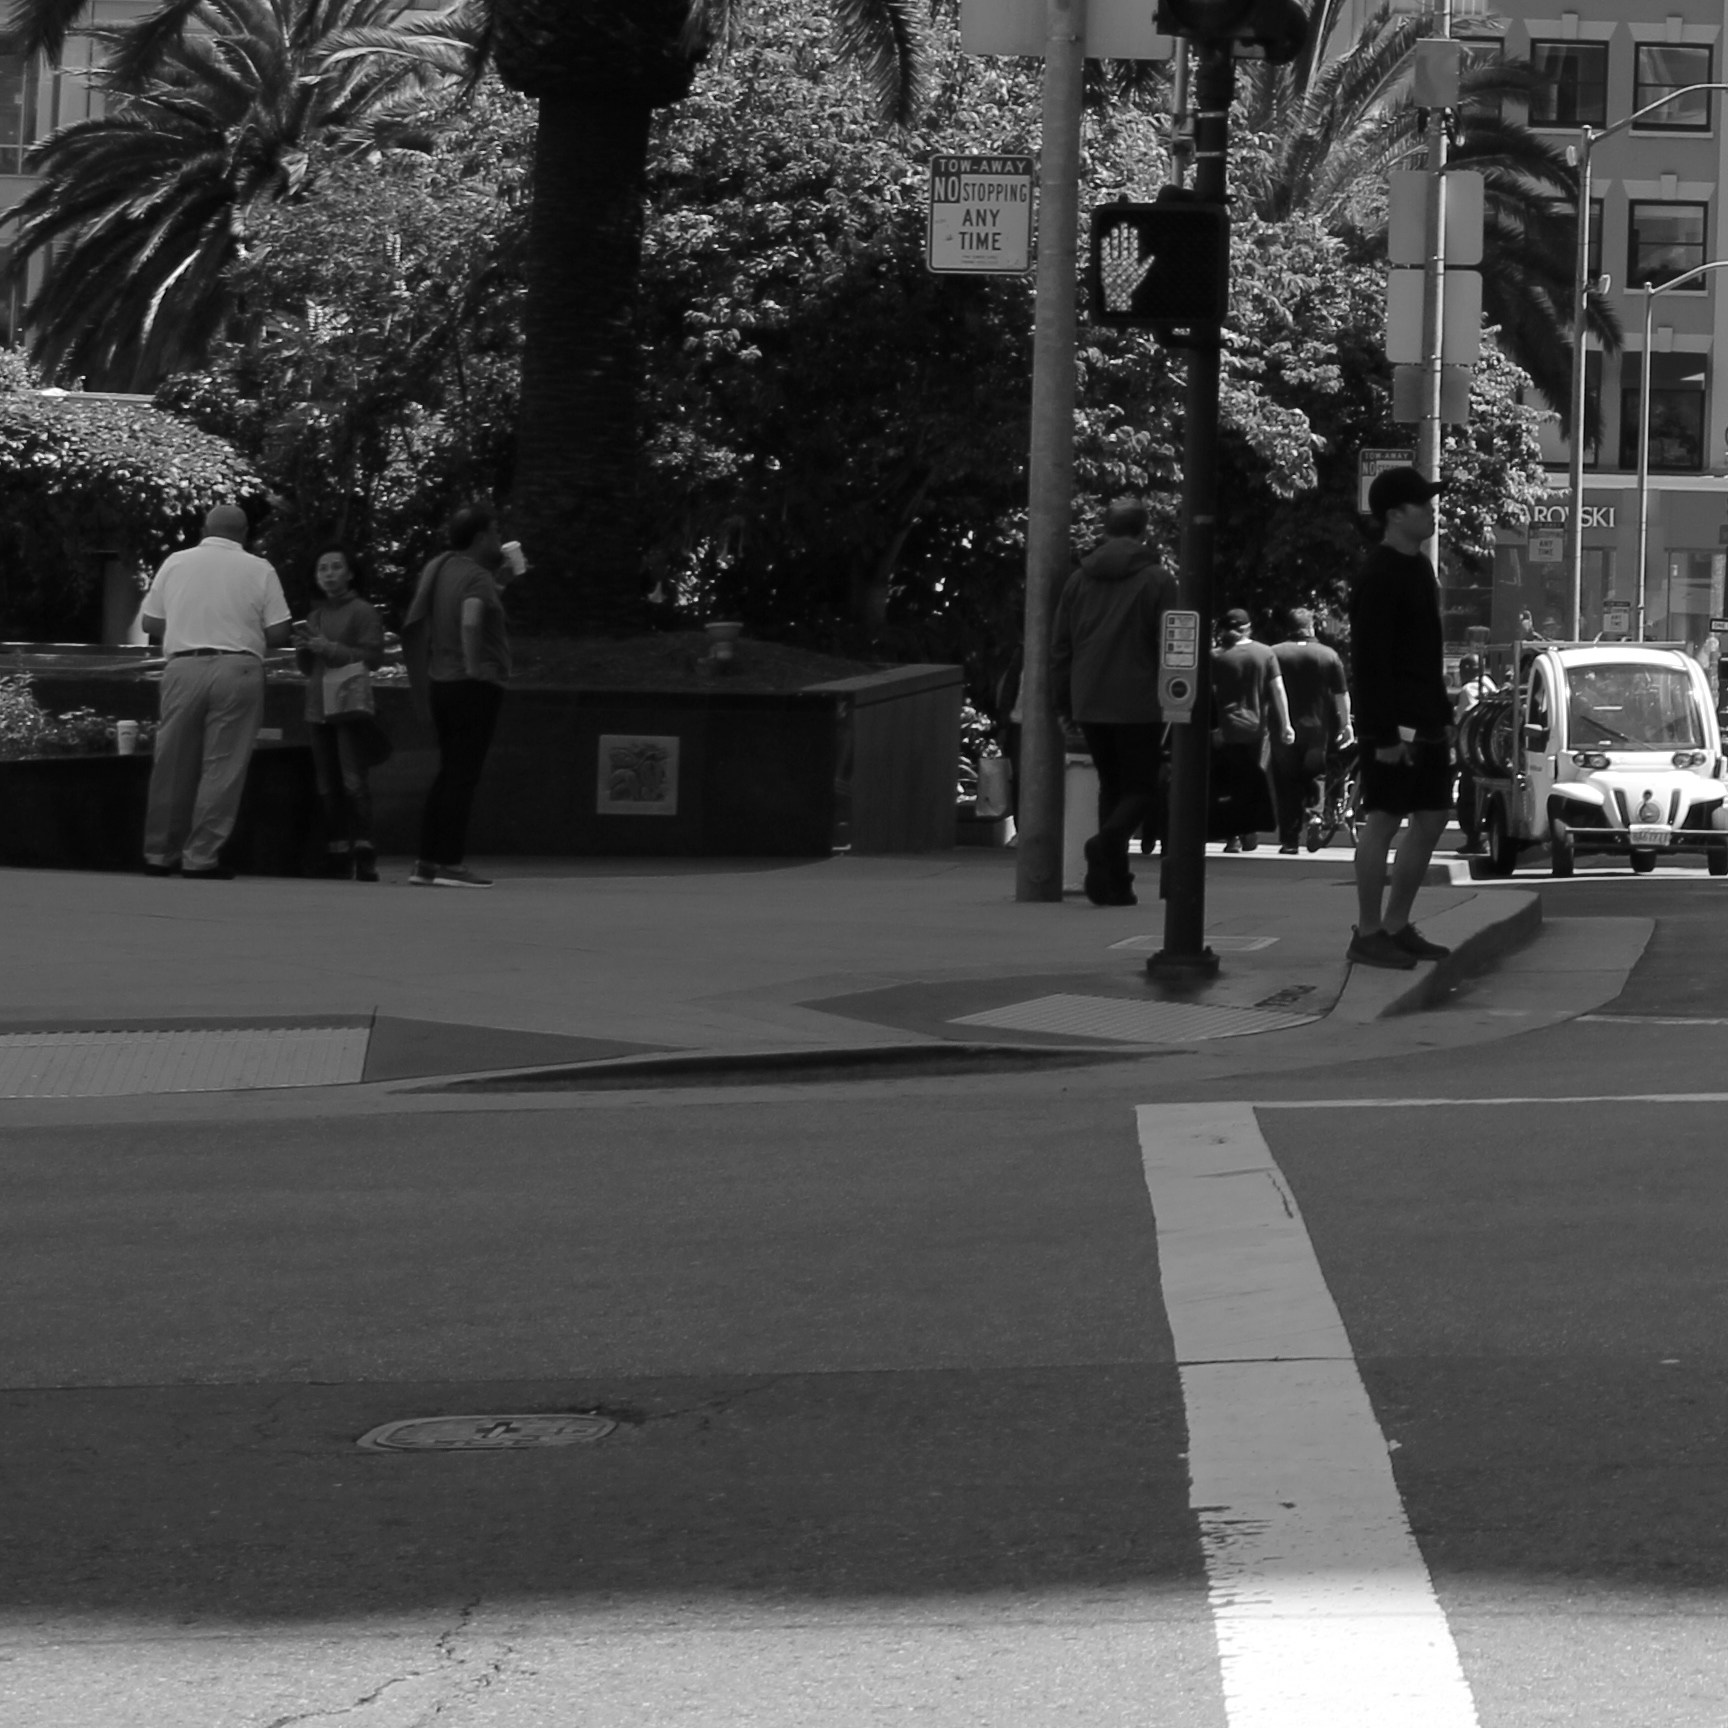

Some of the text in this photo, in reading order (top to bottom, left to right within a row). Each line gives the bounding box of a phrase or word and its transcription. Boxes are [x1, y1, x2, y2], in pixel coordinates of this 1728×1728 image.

[939, 159, 1028, 174] TOW-AWAY
[934, 176, 1028, 203] NO STOPPING
[962, 208, 1001, 228] ANY
[958, 231, 1003, 251] TIME
[1362, 461, 1376, 475] NO
